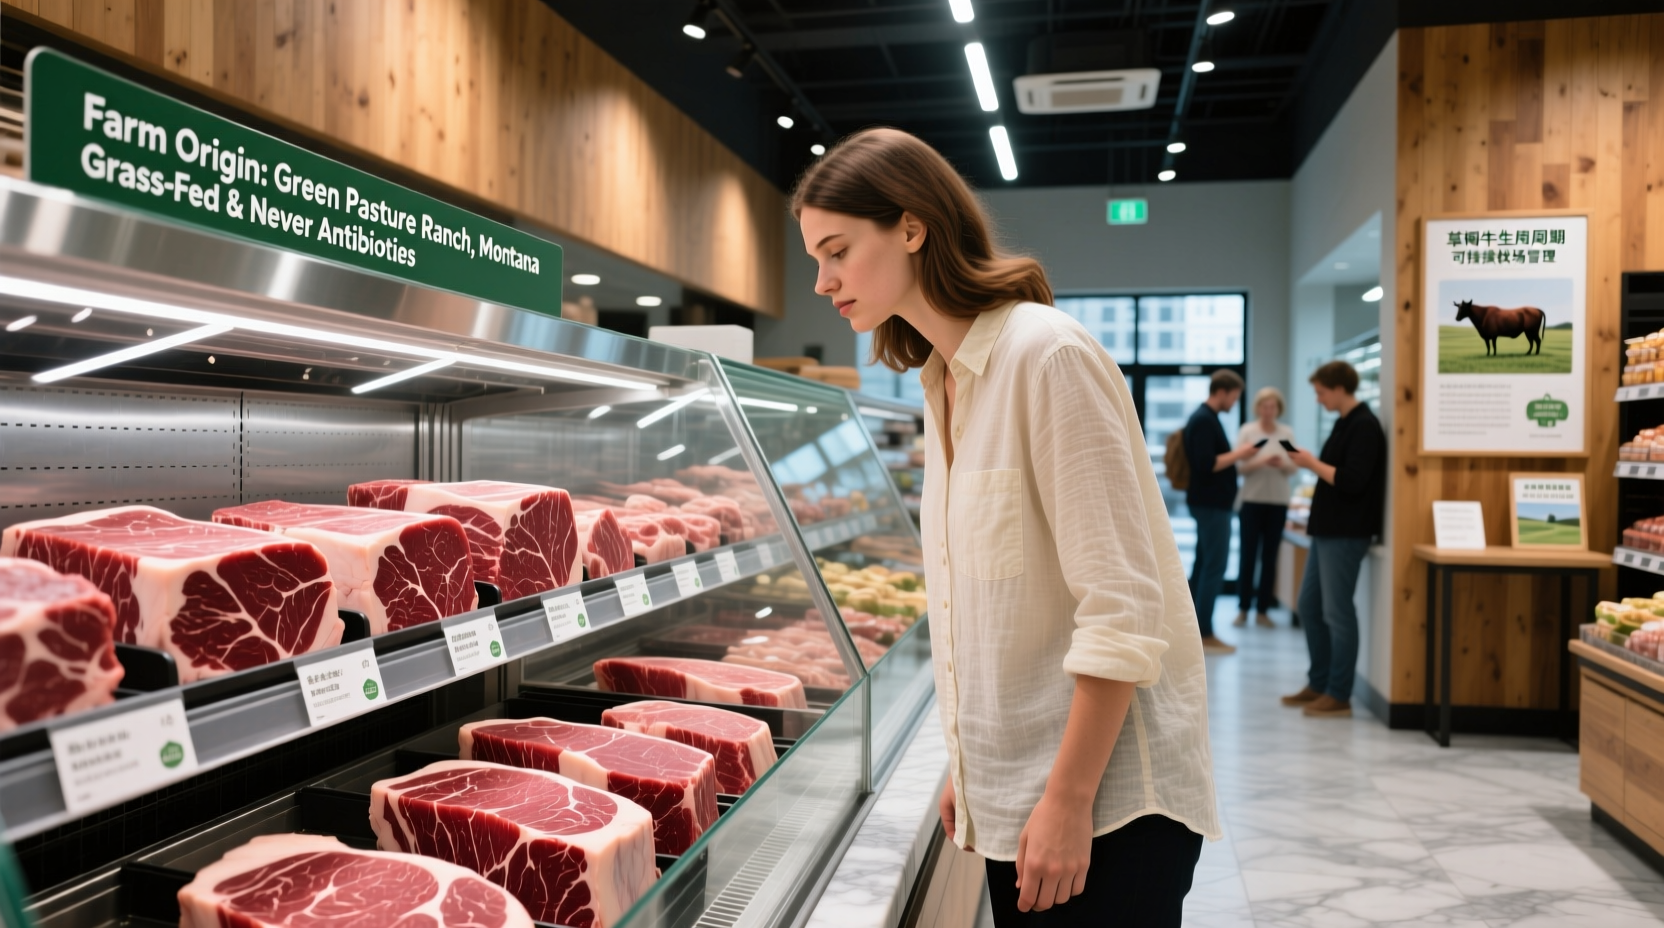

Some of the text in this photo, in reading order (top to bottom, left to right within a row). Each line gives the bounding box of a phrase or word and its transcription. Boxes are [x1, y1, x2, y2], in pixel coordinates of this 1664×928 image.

[80, 142, 220, 213] Grass-Fed
[225, 188, 244, 220] &
[250, 194, 314, 238] Never
[83, 92, 540, 275] Farm Origin: Green Pasture Ranch, Montana
